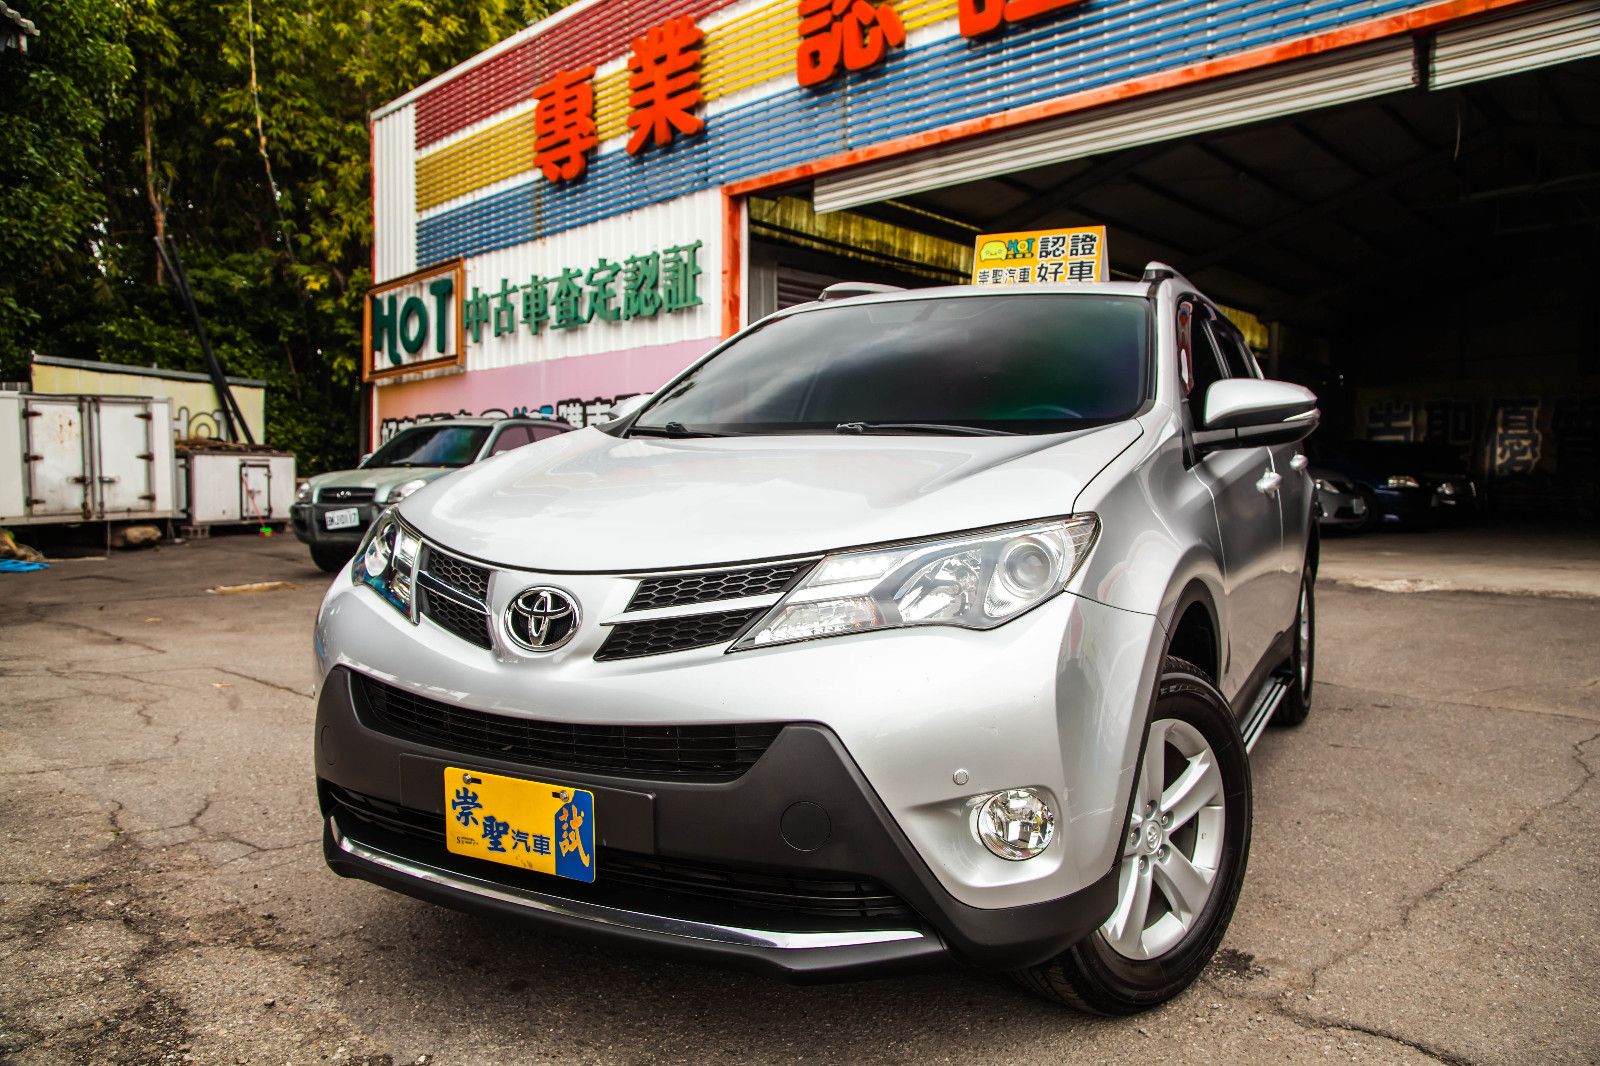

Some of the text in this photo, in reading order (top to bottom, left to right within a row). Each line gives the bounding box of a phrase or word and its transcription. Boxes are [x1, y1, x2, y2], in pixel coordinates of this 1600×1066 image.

[533, 14, 704, 184] 專業
[1007, 238, 1036, 254] HOT
[1039, 233, 1097, 259] 認證
[1037, 260, 1095, 282] 好車
[374, 279, 453, 366] HOT
